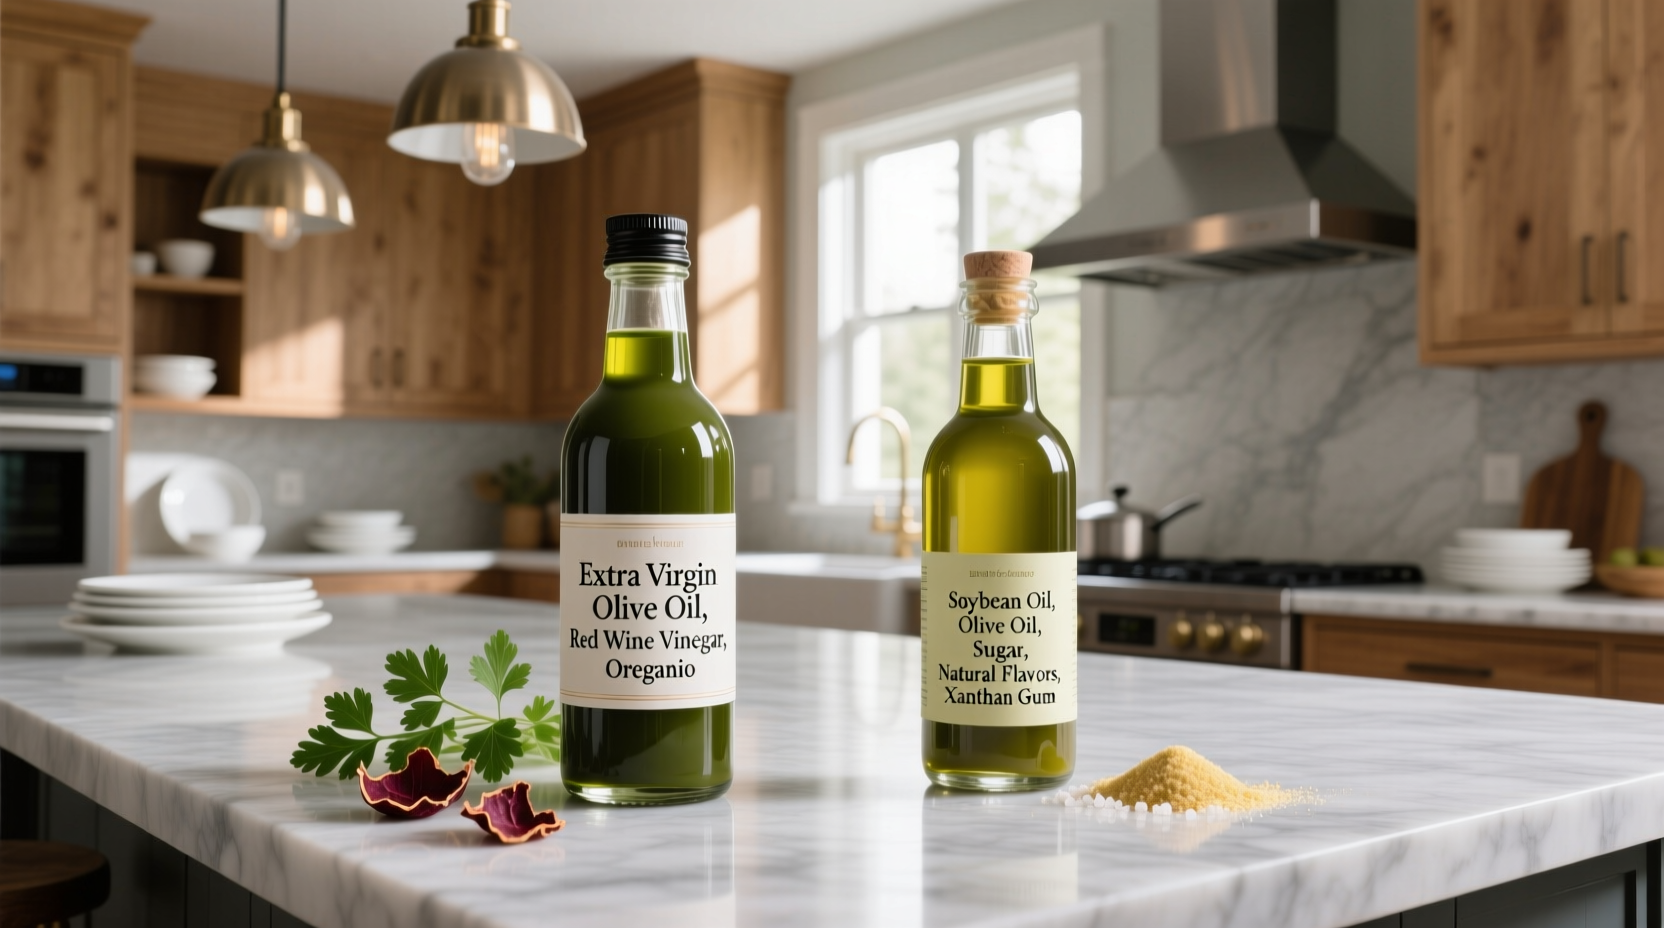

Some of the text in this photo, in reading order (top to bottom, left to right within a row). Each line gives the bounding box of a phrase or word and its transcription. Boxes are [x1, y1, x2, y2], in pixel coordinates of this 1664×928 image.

[579, 562, 717, 593] Extra Virgin
[592, 593, 708, 624] Olive Oil,
[948, 591, 1056, 615] Soybean Oil,
[958, 615, 1042, 637] Olive Oil,
[570, 628, 727, 654] Red Wine Vinegar,
[973, 640, 1029, 663] Sugar,
[605, 659, 696, 685] Oreganio
[938, 663, 1061, 684] Natural Flavors,
[944, 686, 1056, 705] Xanthan Gum
